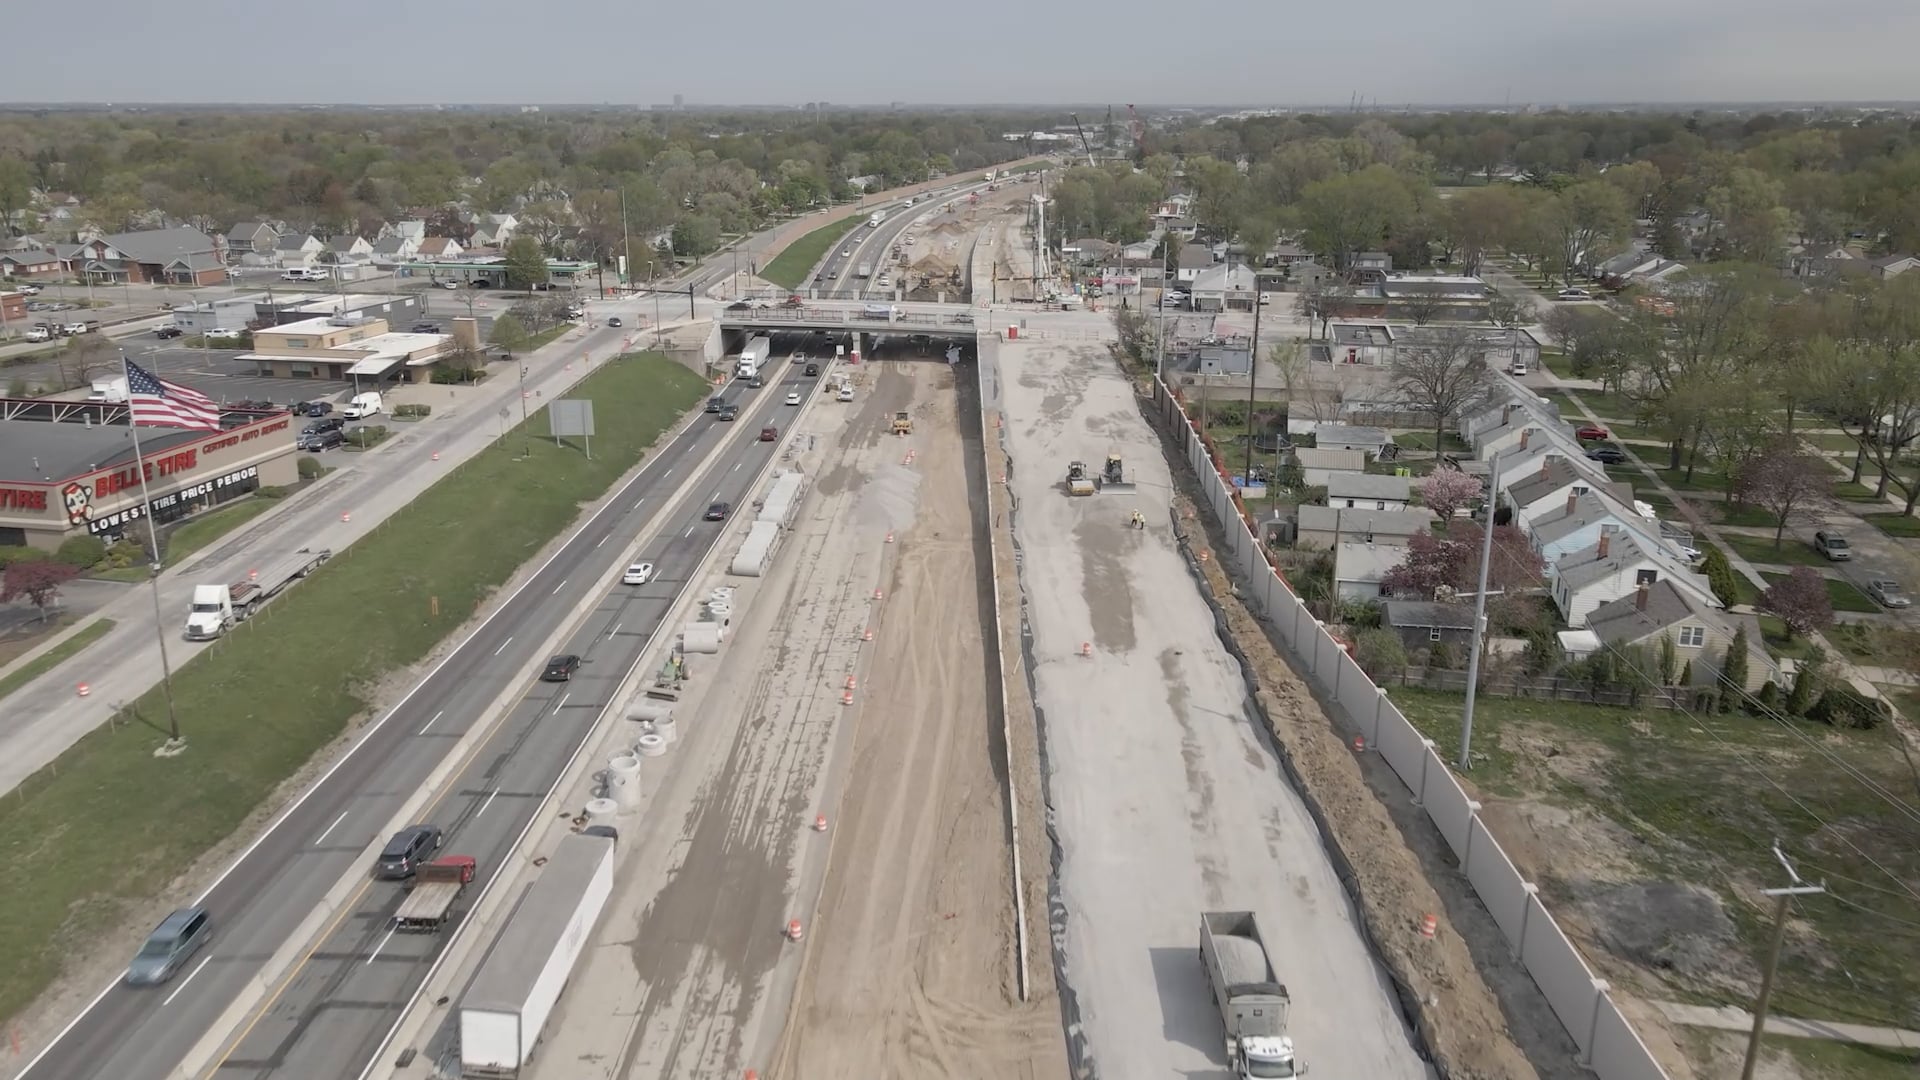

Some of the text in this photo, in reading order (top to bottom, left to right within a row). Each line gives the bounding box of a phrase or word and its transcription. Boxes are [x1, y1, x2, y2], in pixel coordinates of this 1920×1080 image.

[202, 420, 289, 455] CERTIFIED AUTO SERVICE
[95, 448, 198, 499] BELLE TIRE
[0, 488, 47, 511] TIRE
[90, 466, 257, 533] LOWEST TIRE PRICE PERIOD!
